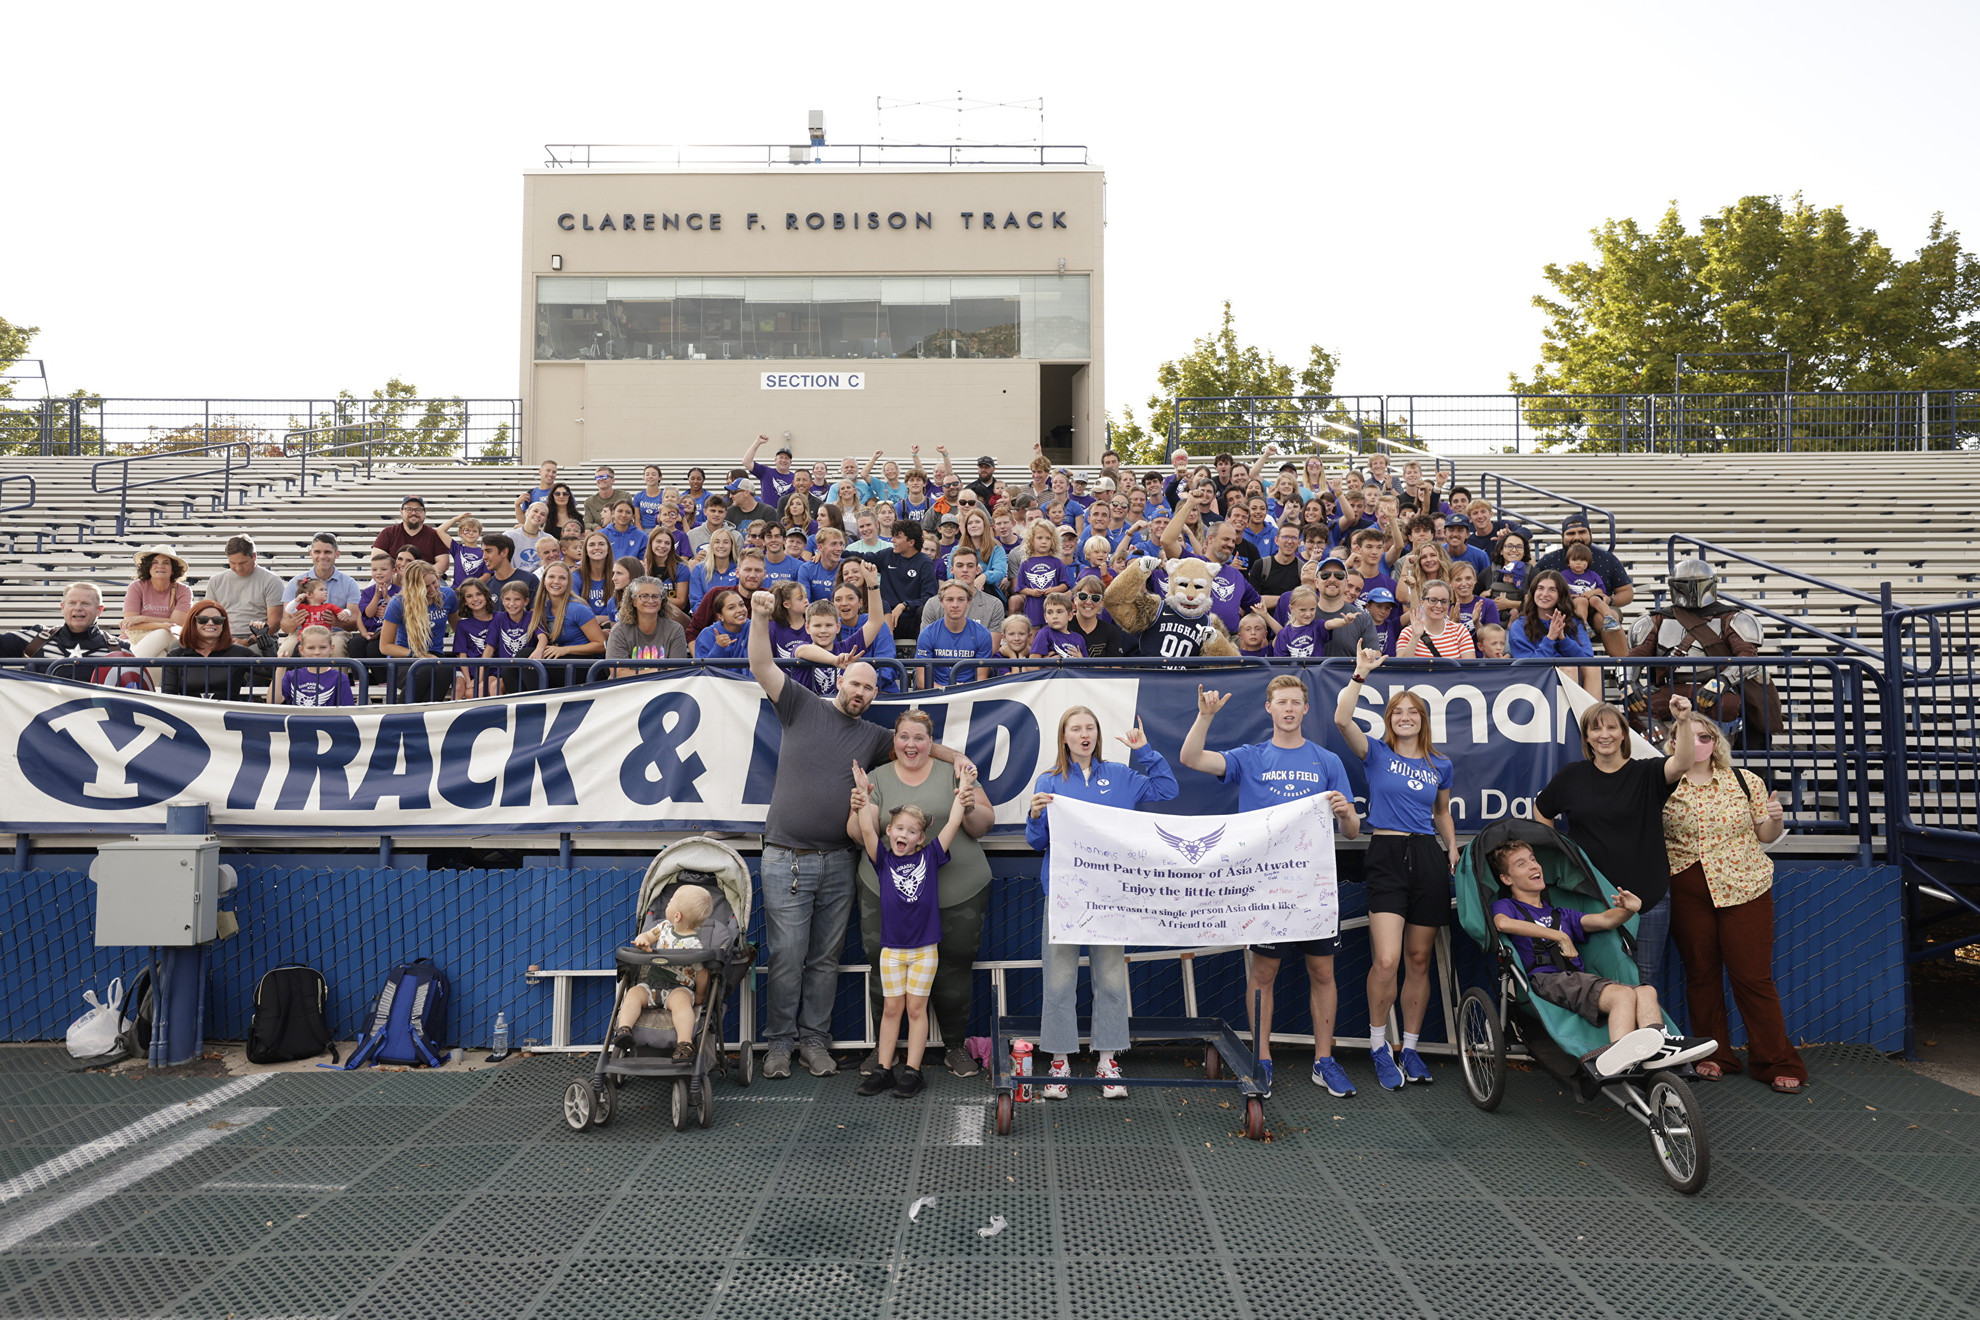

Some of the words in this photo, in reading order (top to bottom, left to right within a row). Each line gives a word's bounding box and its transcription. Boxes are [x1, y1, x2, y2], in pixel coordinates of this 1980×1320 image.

[557, 213, 721, 231] CLARENCE
[746, 213, 765, 230] F.
[785, 212, 932, 230] ROBISON
[961, 211, 1067, 229] TRACK
[766, 375, 839, 387] SECTION
[848, 375, 859, 387] C
[224, 699, 596, 811] TRACK
[619, 691, 708, 806] &
[1262, 770, 1287, 781] TRACK
[1288, 770, 1295, 780] &
[1296, 770, 1319, 783] FIELD
[1283, 787, 1311, 797] COUGARS
[1074, 857, 1110, 871] Donut
[1113, 863, 1151, 878] Party
[1154, 868, 1165, 878] in
[1168, 869, 1206, 879] honor
[1209, 868, 1224, 878] of
[1226, 866, 1252, 877] Asia
[1254, 859, 1310, 873] Atwater
[1159, 886, 1180, 896] the
[1185, 887, 1216, 897] little
[1085, 901, 1115, 911] There
[1117, 905, 1149, 914] wasn't
[1159, 909, 1187, 920] single
[1190, 906, 1224, 917] person
[1225, 904, 1247, 913] Asia
[1248, 901, 1276, 911] didn't
[1158, 919, 1166, 927] A
[1169, 920, 1200, 929] friend
[1202, 921, 1212, 929] to
